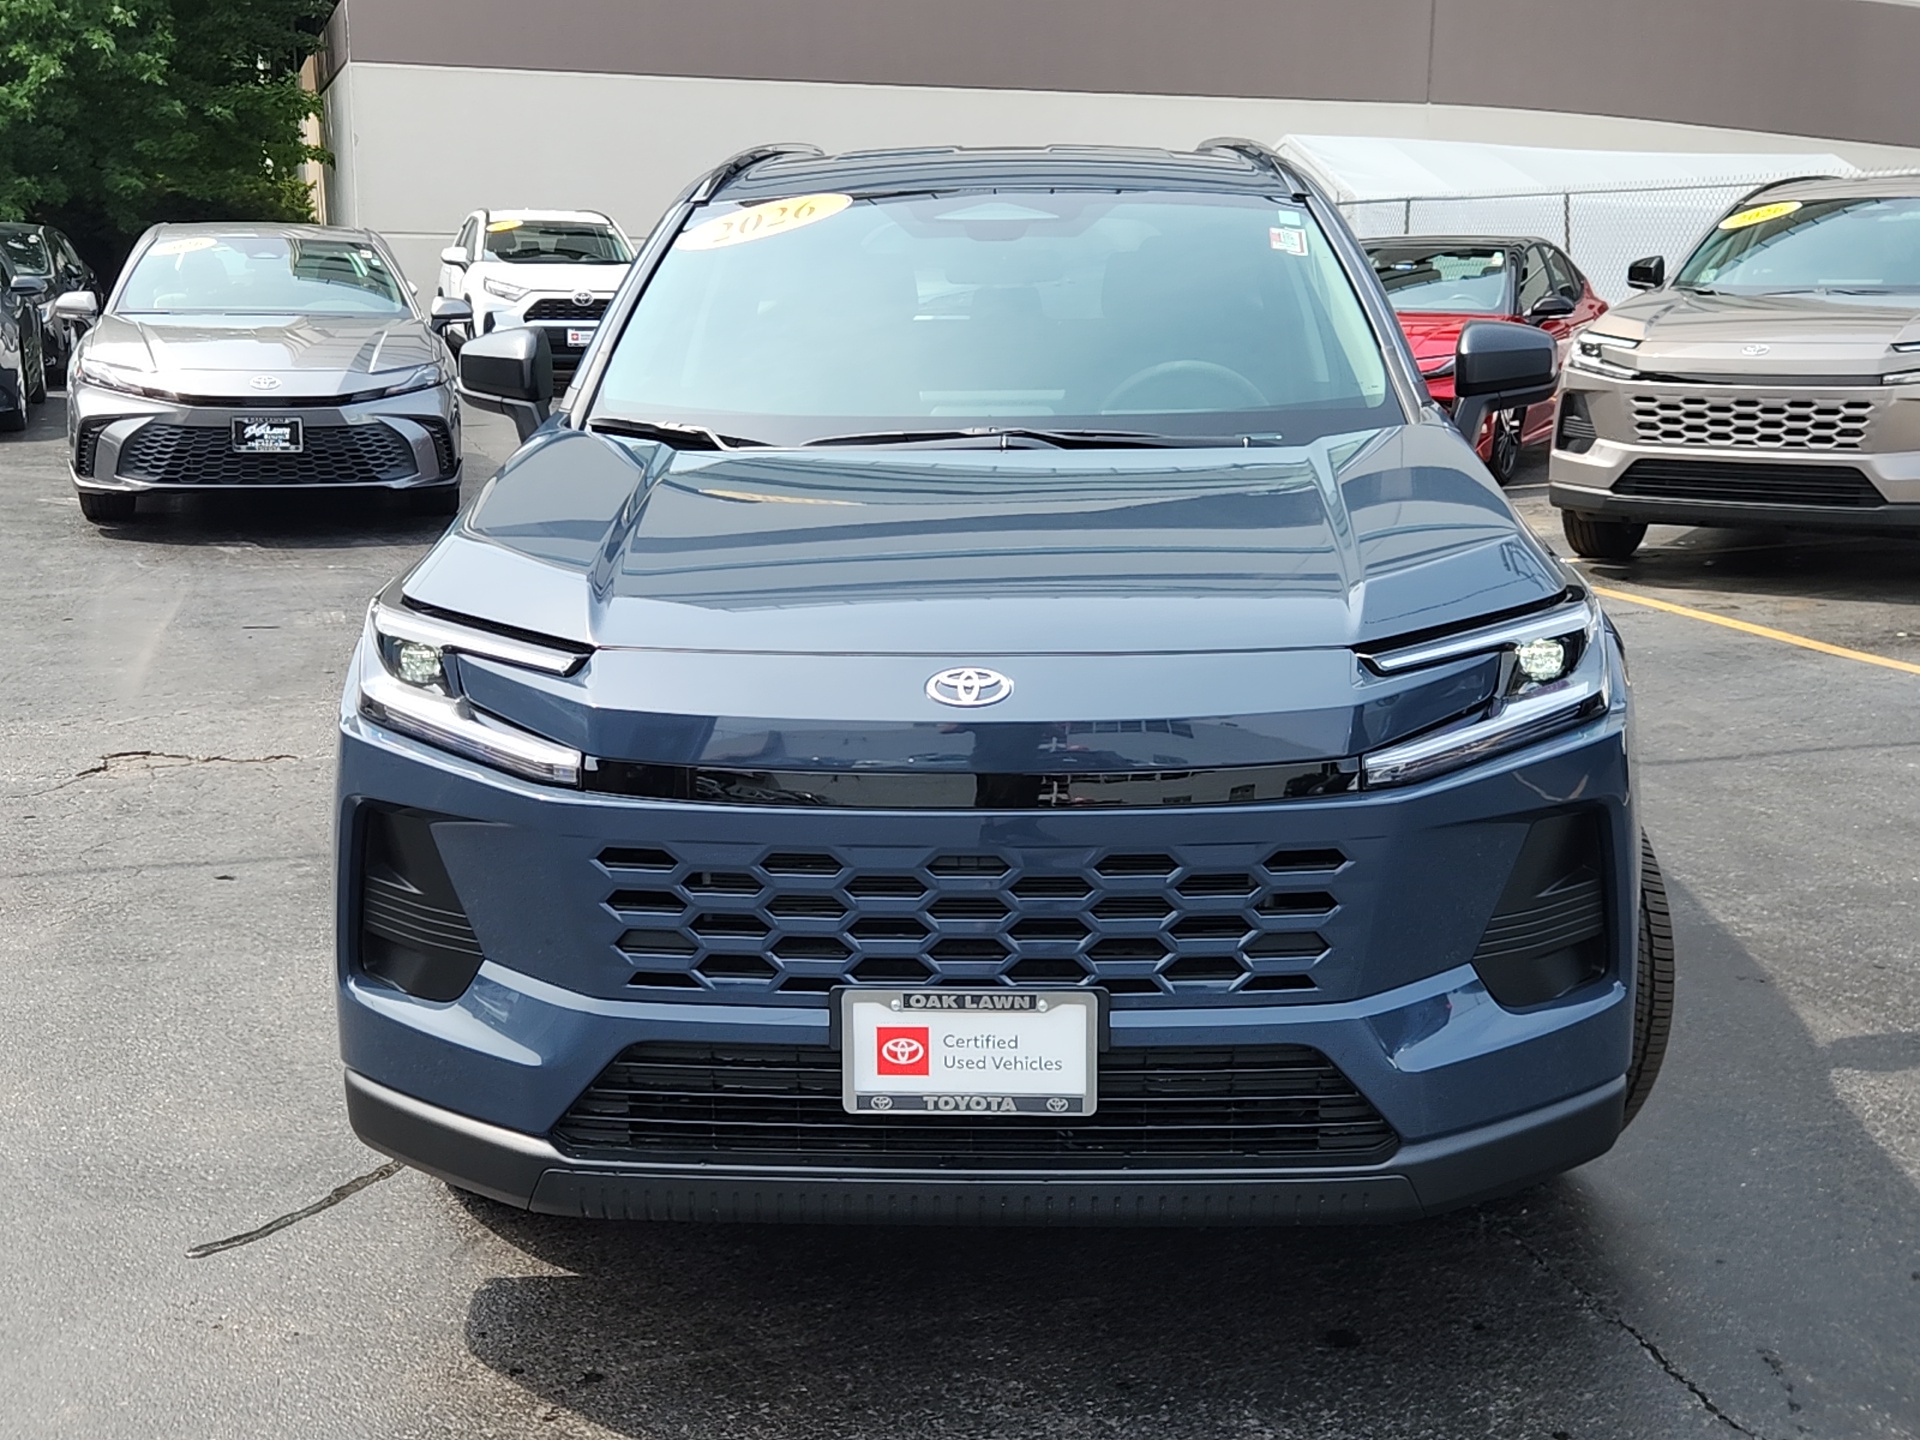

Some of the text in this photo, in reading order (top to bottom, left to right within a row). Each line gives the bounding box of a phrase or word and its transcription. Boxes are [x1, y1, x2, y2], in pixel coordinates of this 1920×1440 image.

[713, 198, 817, 243] 2026
[908, 994, 1030, 1010] OAK LAWN
[942, 1034, 1019, 1050] Certified
[943, 1056, 1063, 1072] Used Vehicles
[922, 1096, 1018, 1113] TOYOTA
